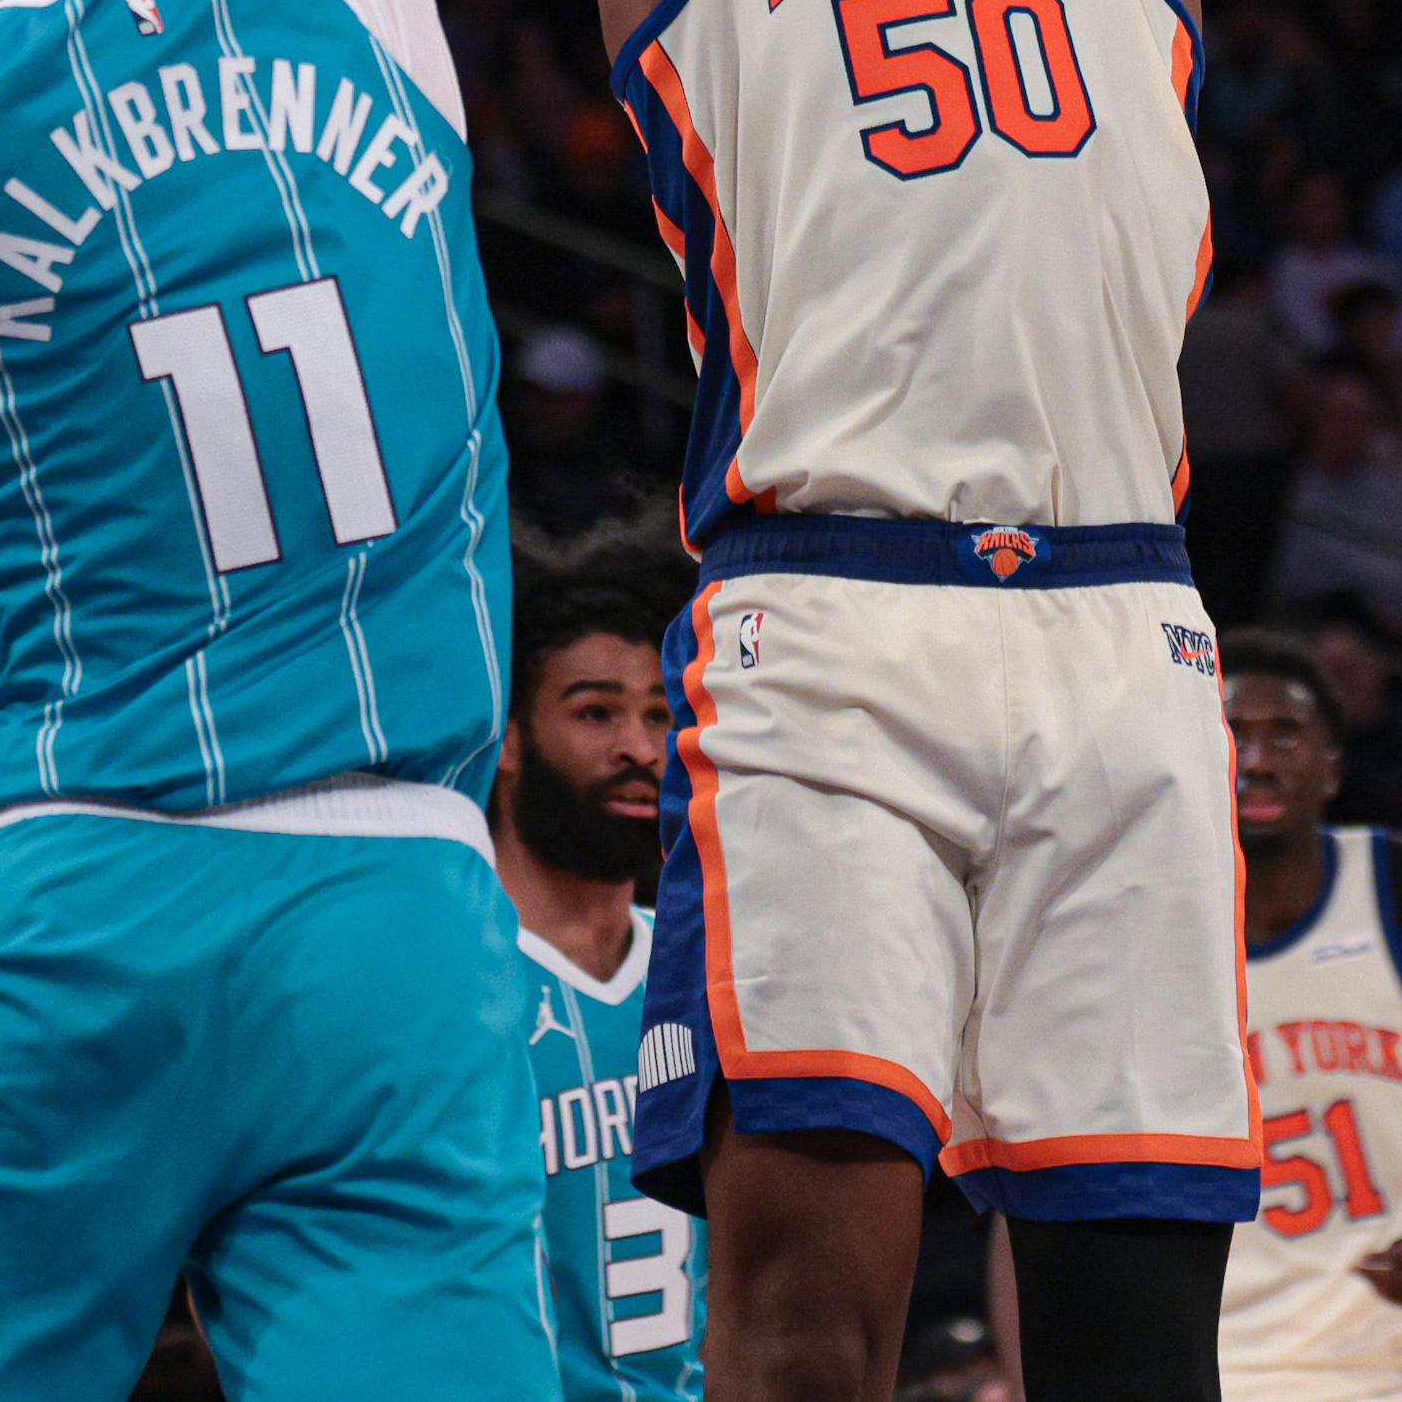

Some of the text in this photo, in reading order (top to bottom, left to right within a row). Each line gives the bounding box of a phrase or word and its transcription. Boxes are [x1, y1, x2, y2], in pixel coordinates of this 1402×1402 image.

[128, 275, 398, 575] 11
[976, 531, 1036, 557] KNICKS
[1161, 623, 1215, 676] NYC
[1260, 1098, 1386, 1239] 51
[602, 1197, 691, 1358] 3
